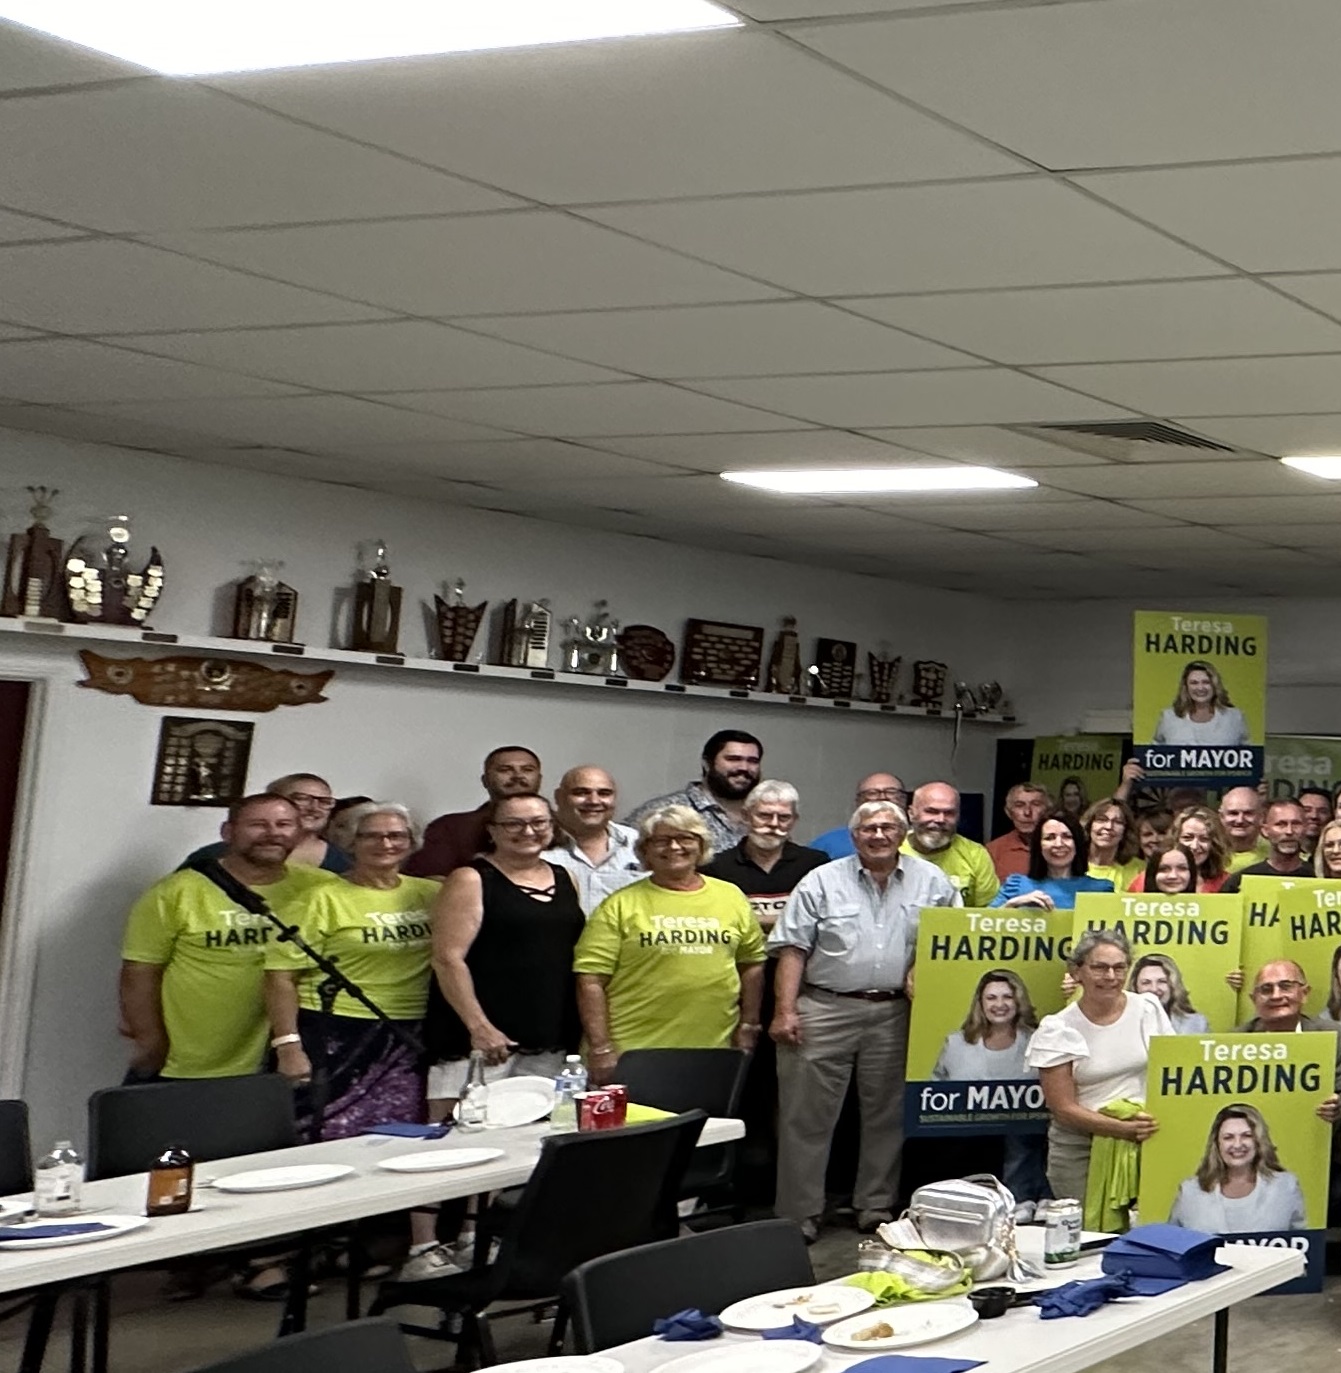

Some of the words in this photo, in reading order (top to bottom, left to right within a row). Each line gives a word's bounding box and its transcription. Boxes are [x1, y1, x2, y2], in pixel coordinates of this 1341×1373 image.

[1172, 617, 1233, 634] Teresa
[1146, 633, 1257, 657] HARDING
[1038, 753, 1114, 771] HARDING
[1145, 749, 1175, 769] for
[1181, 749, 1253, 769] MAYOR
[1120, 897, 1200, 917] Teresa
[651, 914, 720, 931] Teresa
[967, 913, 1047, 933] Teresa
[1087, 919, 1229, 945] HARDING
[362, 922, 432, 944] HARDI
[639, 929, 732, 948] HARDING
[1199, 1040, 1288, 1062] Teresa
[1161, 1063, 1321, 1097] HARDING
[920, 1087, 960, 1111] for
[966, 1084, 1045, 1110] MAYO
